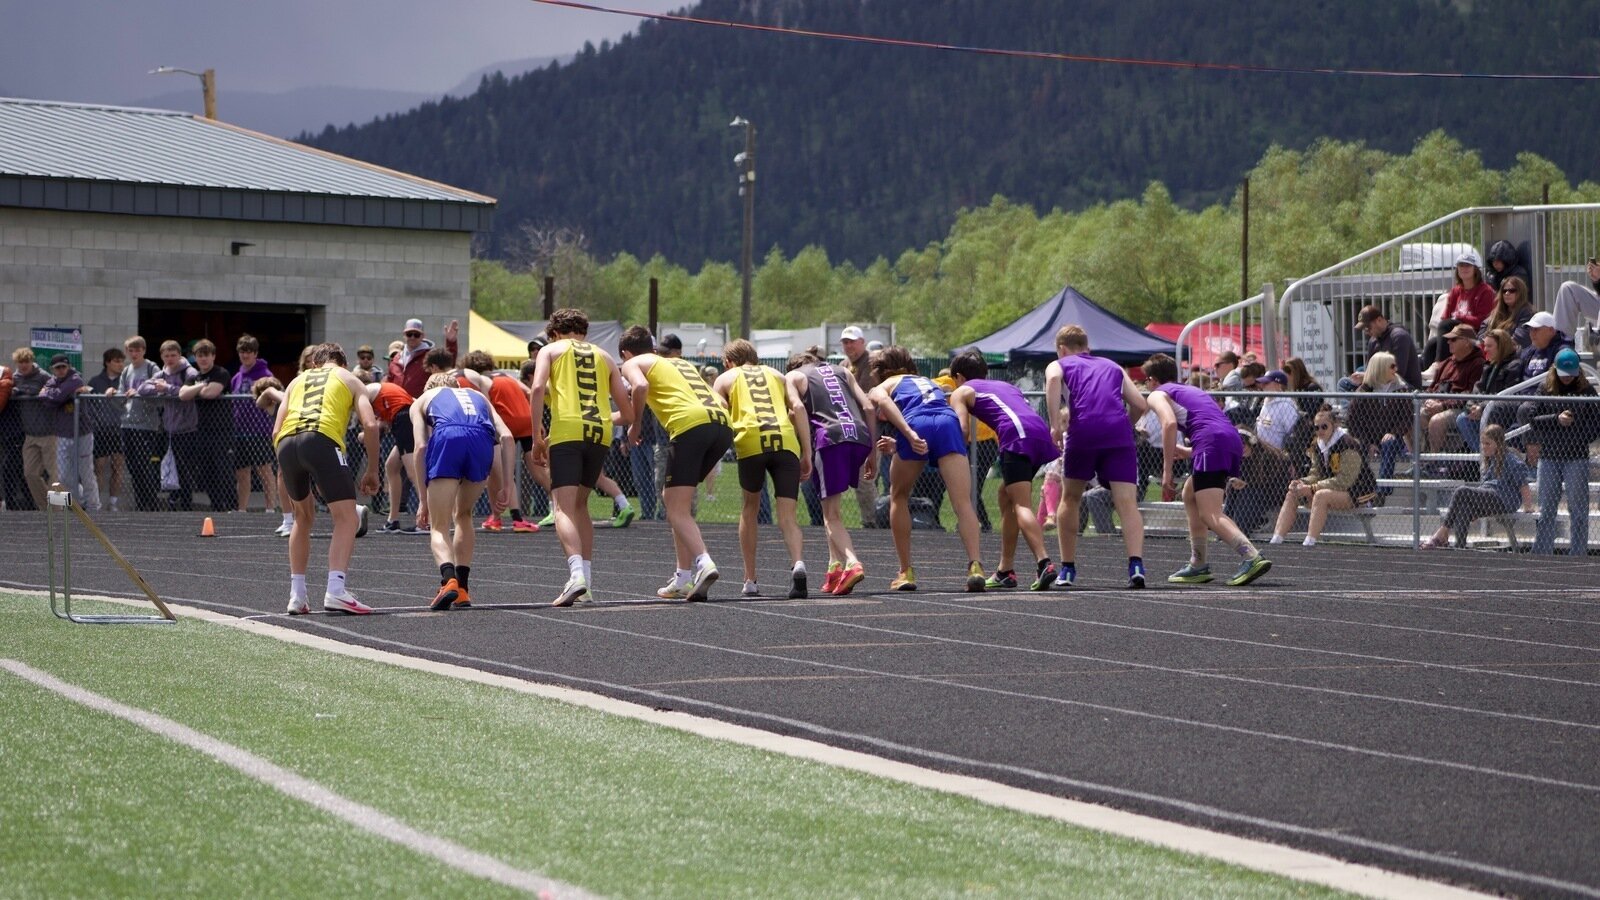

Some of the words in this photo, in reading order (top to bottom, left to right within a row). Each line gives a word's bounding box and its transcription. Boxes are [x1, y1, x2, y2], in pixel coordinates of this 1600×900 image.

[571, 340, 604, 445] BRUINS
[668, 359, 729, 425] RUINS
[740, 366, 784, 453] BRUINS
[816, 363, 858, 441] BUTTE
